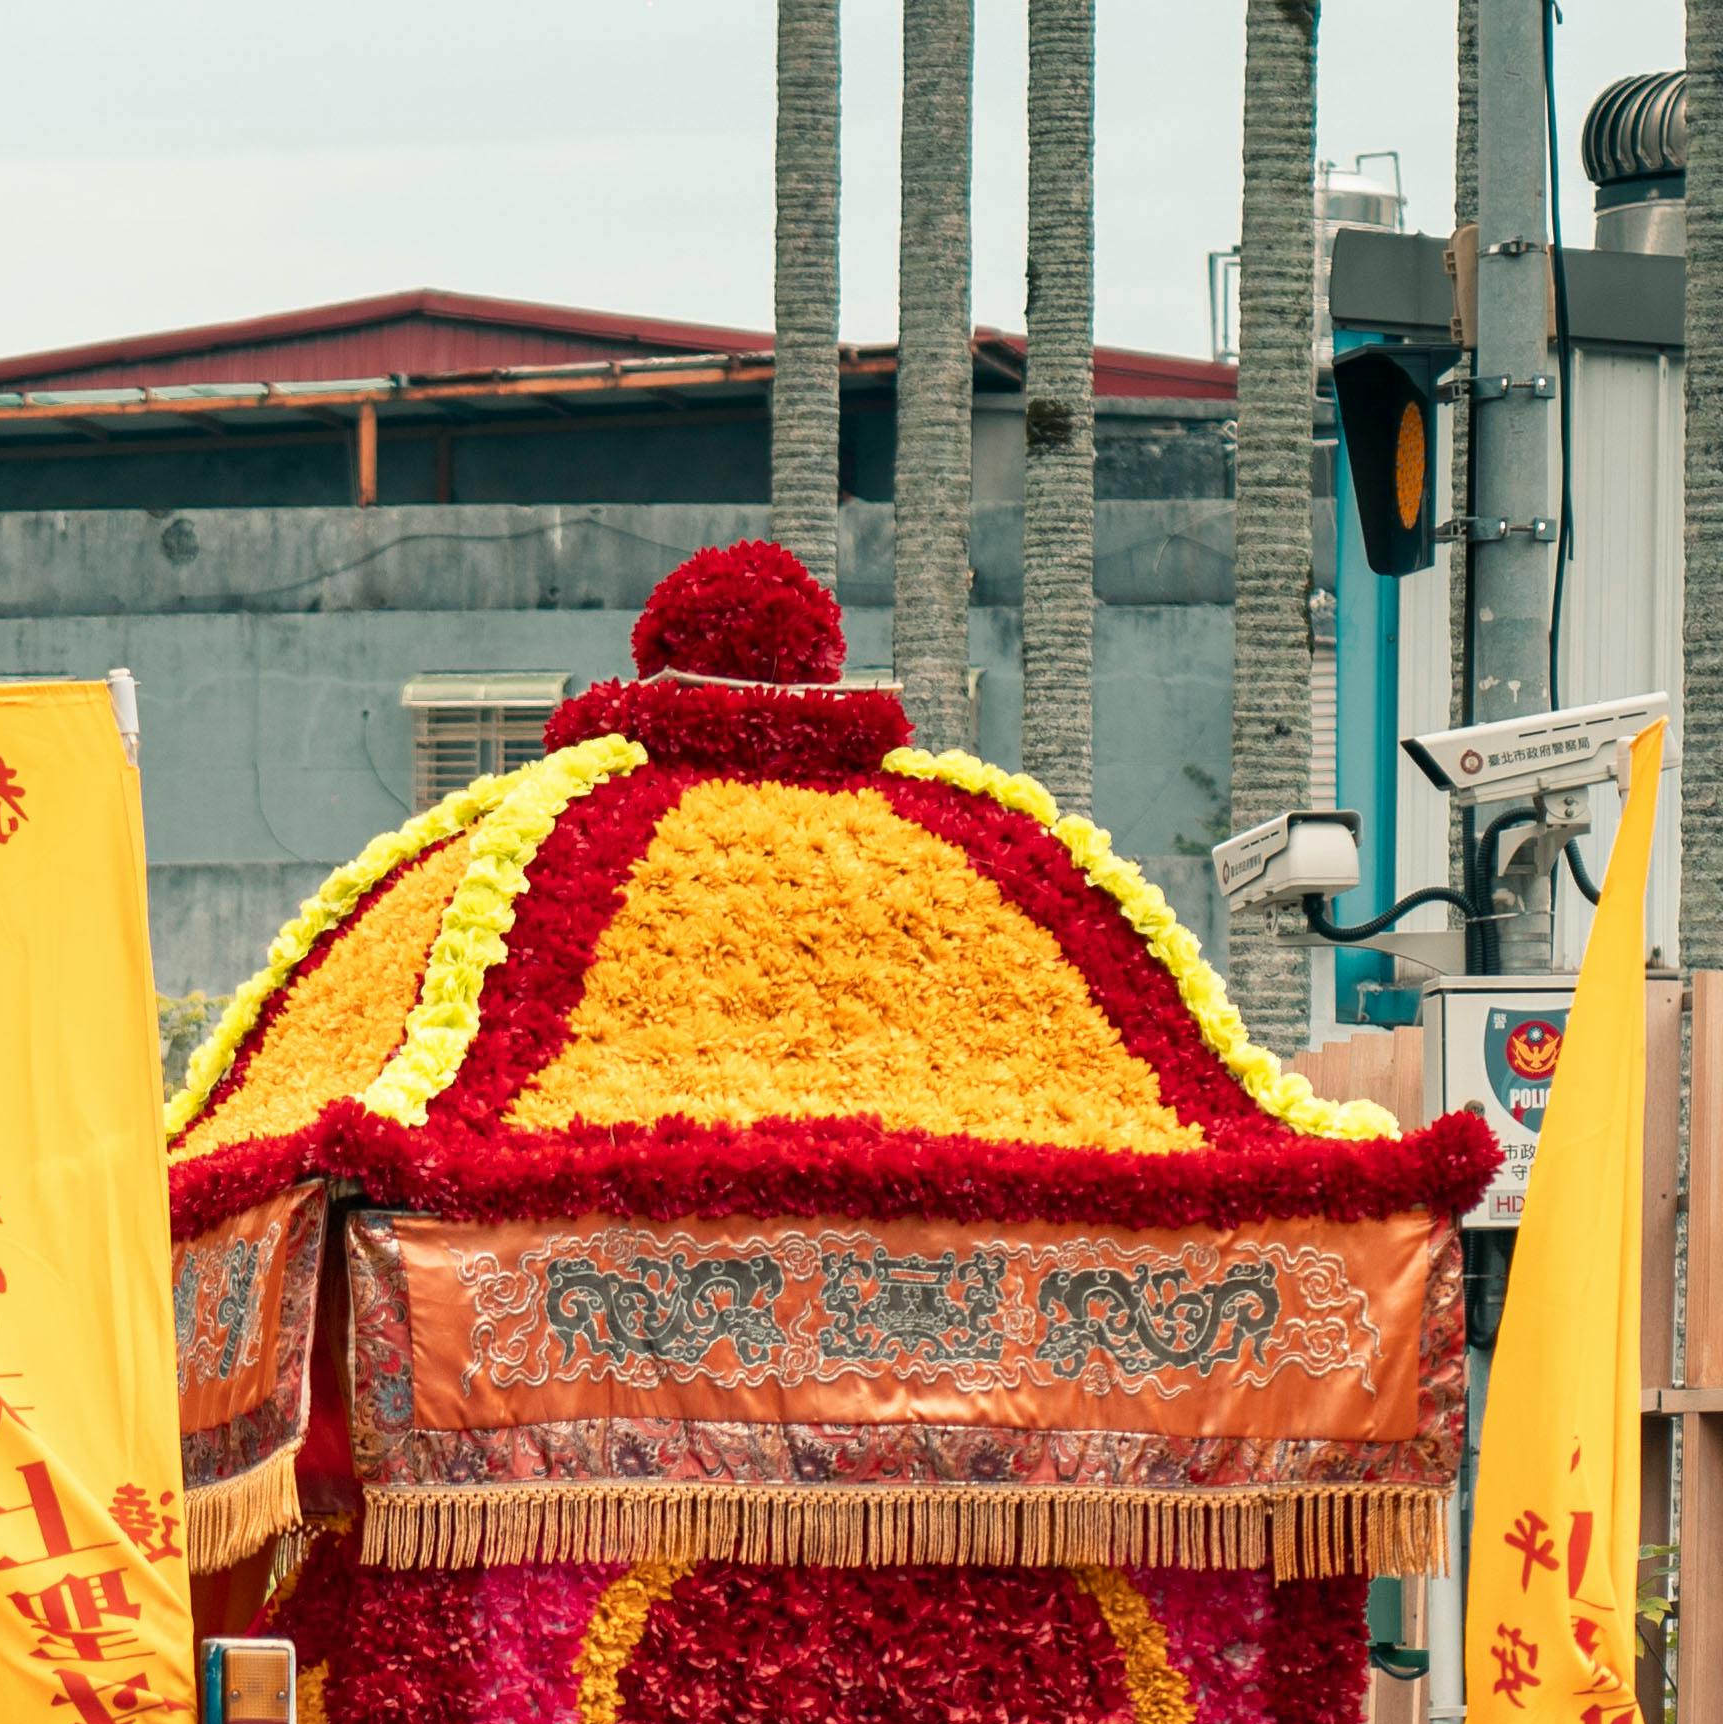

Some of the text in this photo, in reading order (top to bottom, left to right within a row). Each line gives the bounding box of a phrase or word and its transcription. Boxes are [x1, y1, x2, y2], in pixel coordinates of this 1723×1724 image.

[1487, 737, 1590, 768] 臺北市政府警察局
